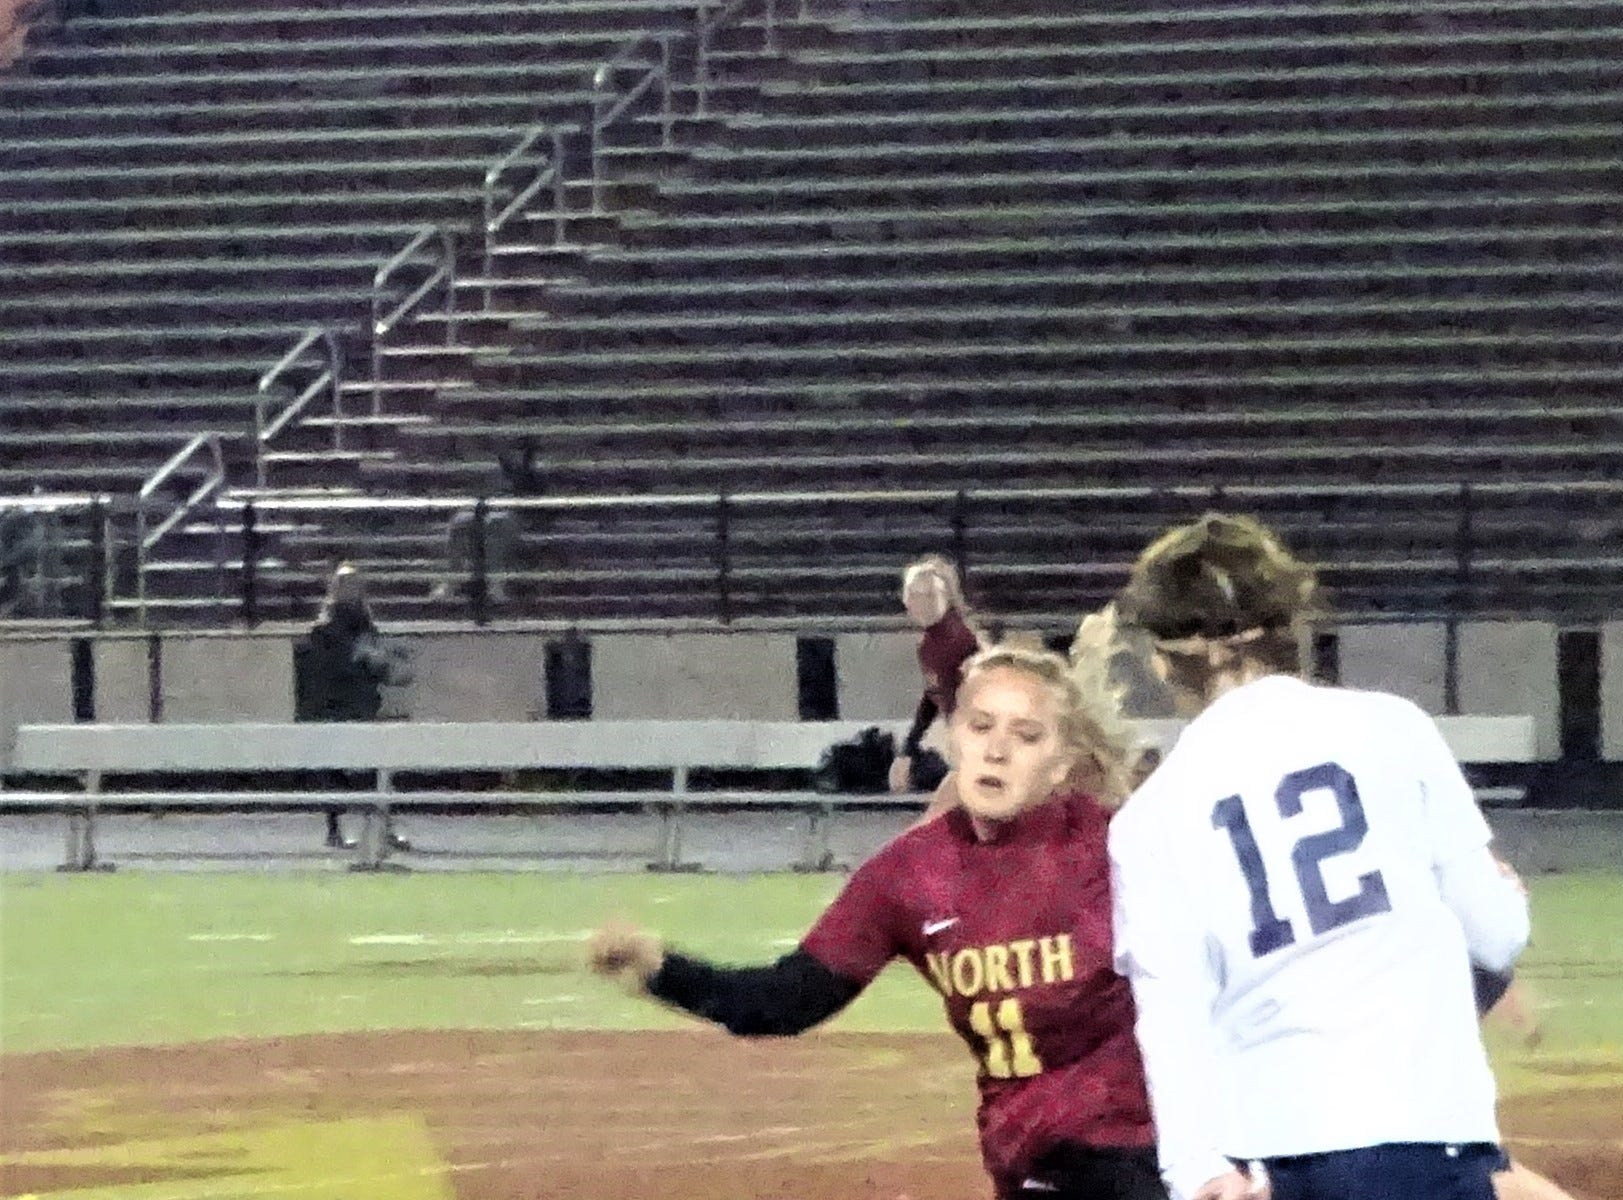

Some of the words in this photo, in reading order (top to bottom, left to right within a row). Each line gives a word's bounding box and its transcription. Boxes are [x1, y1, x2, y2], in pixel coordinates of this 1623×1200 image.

[1211, 760, 1393, 959] 12
[925, 932, 1075, 998] NORTH
[968, 997, 1044, 1079] 11
